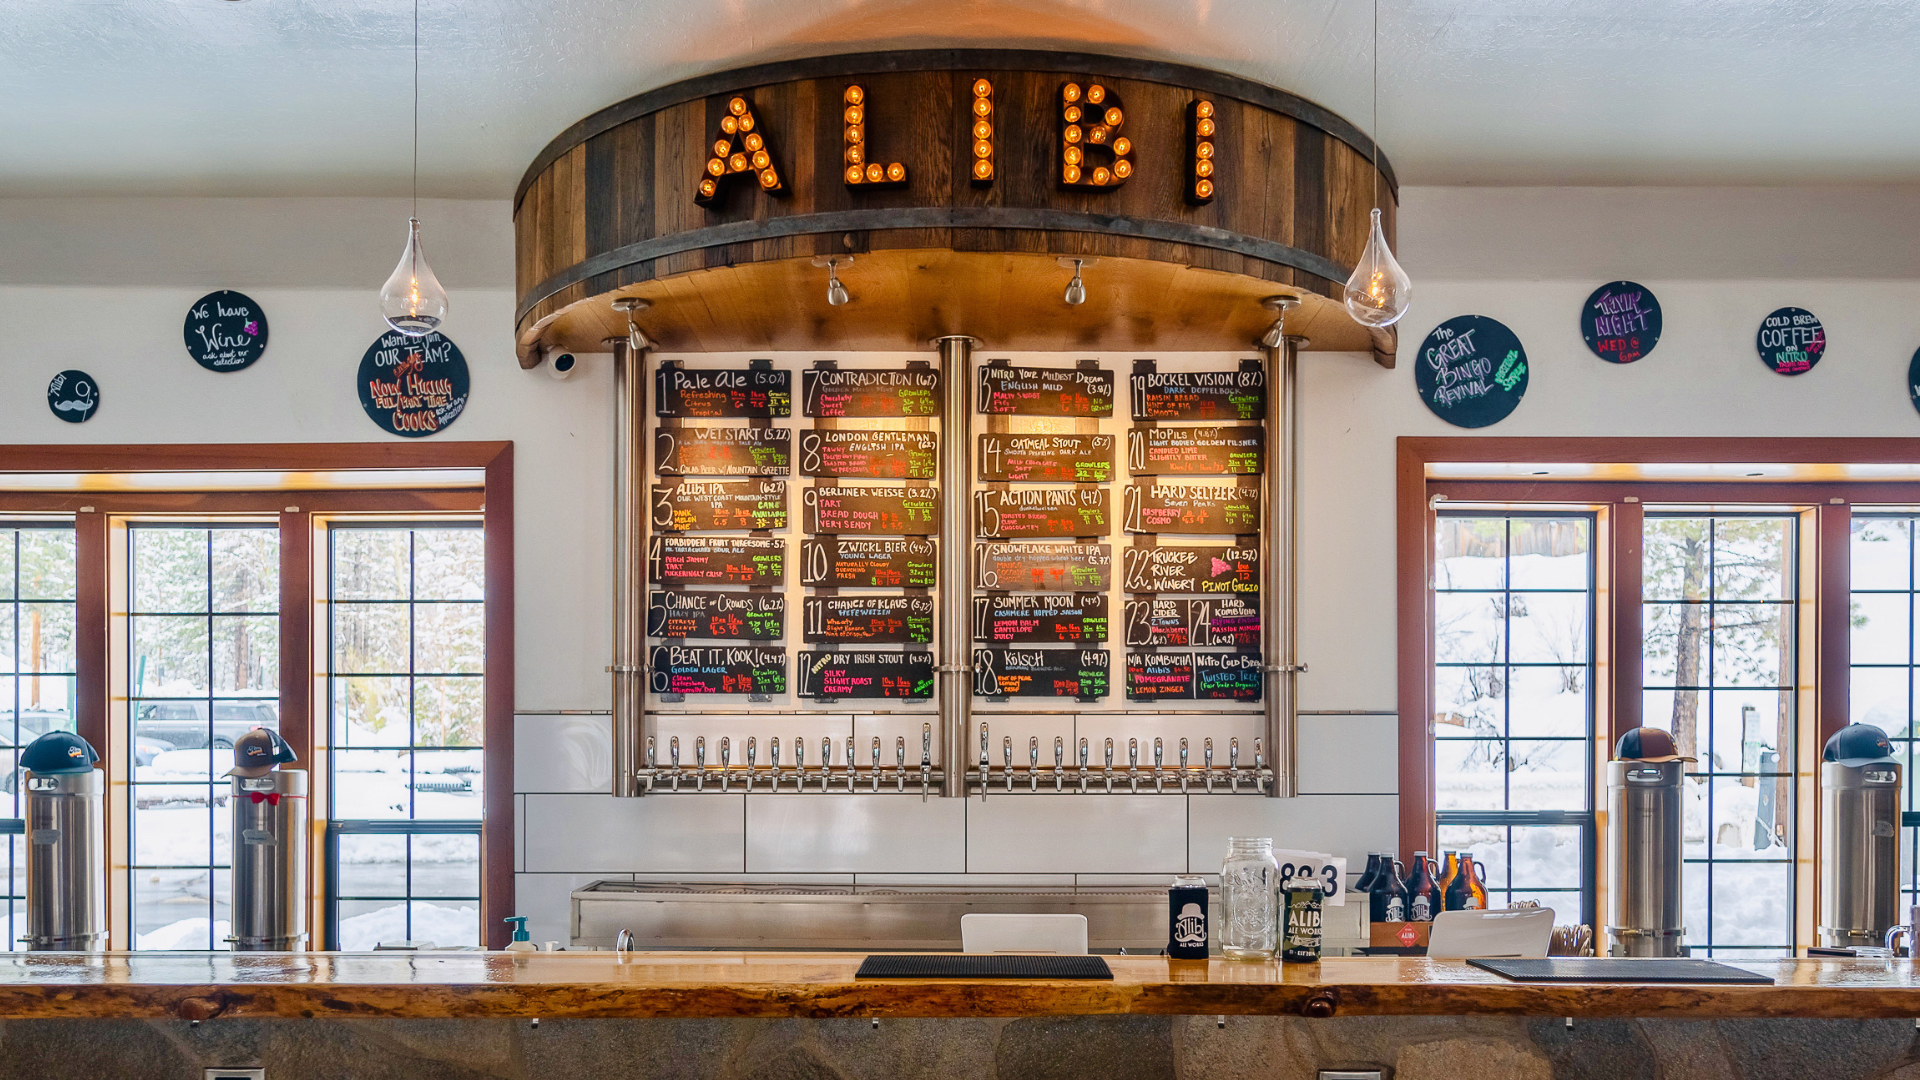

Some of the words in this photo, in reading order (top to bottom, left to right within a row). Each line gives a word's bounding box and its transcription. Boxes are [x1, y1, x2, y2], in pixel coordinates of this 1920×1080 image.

[693, 77, 1215, 207] ALIBI
[192, 303, 209, 320] We
[217, 301, 249, 317] have
[1595, 307, 1652, 336] NIGHT
[1766, 316, 1790, 327] COLD
[1792, 315, 1818, 326] BREW
[195, 323, 251, 352] Wine
[1432, 327, 1454, 340] The
[1762, 326, 1824, 348] COFFEE
[381, 334, 409, 348] Want
[1597, 339, 1626, 352] WED
[1631, 337, 1639, 349] @
[375, 348, 402, 367] OUR
[404, 342, 452, 364] TEAM?
[1425, 328, 1476, 372] GREAT
[1619, 351, 1640, 362] 6pm
[1776, 351, 1809, 363] NITRO
[820, 371, 912, 387] CONTRADICTION
[991, 369, 1014, 381] NITRO
[1148, 374, 1191, 387] BOCKEL
[1194, 373, 1234, 386] VISION
[1238, 371, 1263, 387] (8%)
[1436, 357, 1492, 387] BINGO
[674, 371, 711, 390] Pale
[715, 371, 747, 389] Ale
[755, 372, 785, 385] (5.0%)
[1001, 381, 1038, 391] ENGLISH
[680, 390, 726, 402] Refreshing
[1433, 380, 1494, 409] REVIVAL
[392, 410, 438, 431] COOKS
[695, 429, 722, 439] WET
[726, 428, 761, 440] START
[826, 432, 868, 442] LONDON
[872, 432, 930, 442] GENTLEMAN
[1010, 438, 1049, 449] OATMEAL
[1052, 438, 1081, 448] STOUT
[1091, 436, 1111, 450] (5%)
[983, 438, 1002, 474] 14.
[1129, 432, 1146, 470] 20.
[761, 466, 790, 475] GAZETTE
[676, 483, 706, 495] Alibi
[709, 483, 726, 495] IPA
[819, 487, 868, 496] BERLINER
[871, 488, 904, 497] WEISSE
[908, 488, 936, 500] (3.2%)
[1151, 485, 1186, 498] HARD
[1189, 486, 1237, 500] SELTZER
[820, 499, 842, 508] TART
[1000, 490, 1042, 506] ACTION
[1046, 490, 1076, 506] PANTS
[1081, 489, 1102, 507] (4%)
[1164, 498, 1188, 507] Seven
[820, 510, 849, 518] BREAD
[853, 511, 879, 520] DOUGH
[975, 490, 1000, 537] 15.
[1142, 508, 1181, 518] RASPBERRY
[820, 520, 841, 528] VERY
[844, 521, 872, 530] SENDY
[665, 538, 705, 547] FORBIDDEN
[709, 538, 729, 546] FRUIT
[837, 542, 882, 553] ZWICKL
[885, 542, 907, 552] BIER
[992, 544, 1052, 555] SNOWFLAKE
[1055, 546, 1083, 554] WHITE
[1086, 546, 1101, 556] IPA
[1148, 547, 1198, 564] TRUCKEE
[1226, 548, 1257, 561] (12.5%)
[803, 542, 828, 582] 10.
[976, 544, 1000, 588] 16.
[1150, 564, 1186, 576] RIVER
[1154, 577, 1195, 592] WINERY
[1201, 580, 1231, 592] PINOT
[1231, 578, 1258, 592] GRIGIO
[665, 591, 707, 610] CHANCE
[717, 594, 754, 612] CROWDS
[828, 600, 864, 609] CHANCE
[867, 600, 876, 608] OF
[878, 599, 908, 609] KLAUS
[993, 596, 1039, 610] SUMMER
[1044, 595, 1074, 610] MOON
[1153, 600, 1176, 609] HARD
[1222, 600, 1244, 608] HARD
[669, 610, 688, 618] HAZY
[1125, 601, 1153, 645] 23.
[1192, 601, 1212, 646] 24.
[670, 646, 704, 667] BEAT
[727, 648, 760, 668] KOOK!
[811, 654, 832, 674] NITRO
[833, 654, 850, 664] DRY
[854, 654, 876, 664] IRISH
[878, 654, 904, 664] STOUT
[1127, 655, 1142, 666] N/A
[1145, 654, 1192, 667] KOMBUCHA
[1197, 655, 1220, 667] Nitro
[1221, 654, 1240, 669] COLD
[671, 666, 699, 674] GOLDEN
[702, 666, 728, 674] LAGER
[1198, 670, 1236, 682] TWISTED
[1135, 675, 1190, 683] POMEGRANATE
[1176, 918, 1204, 938] Alibi
